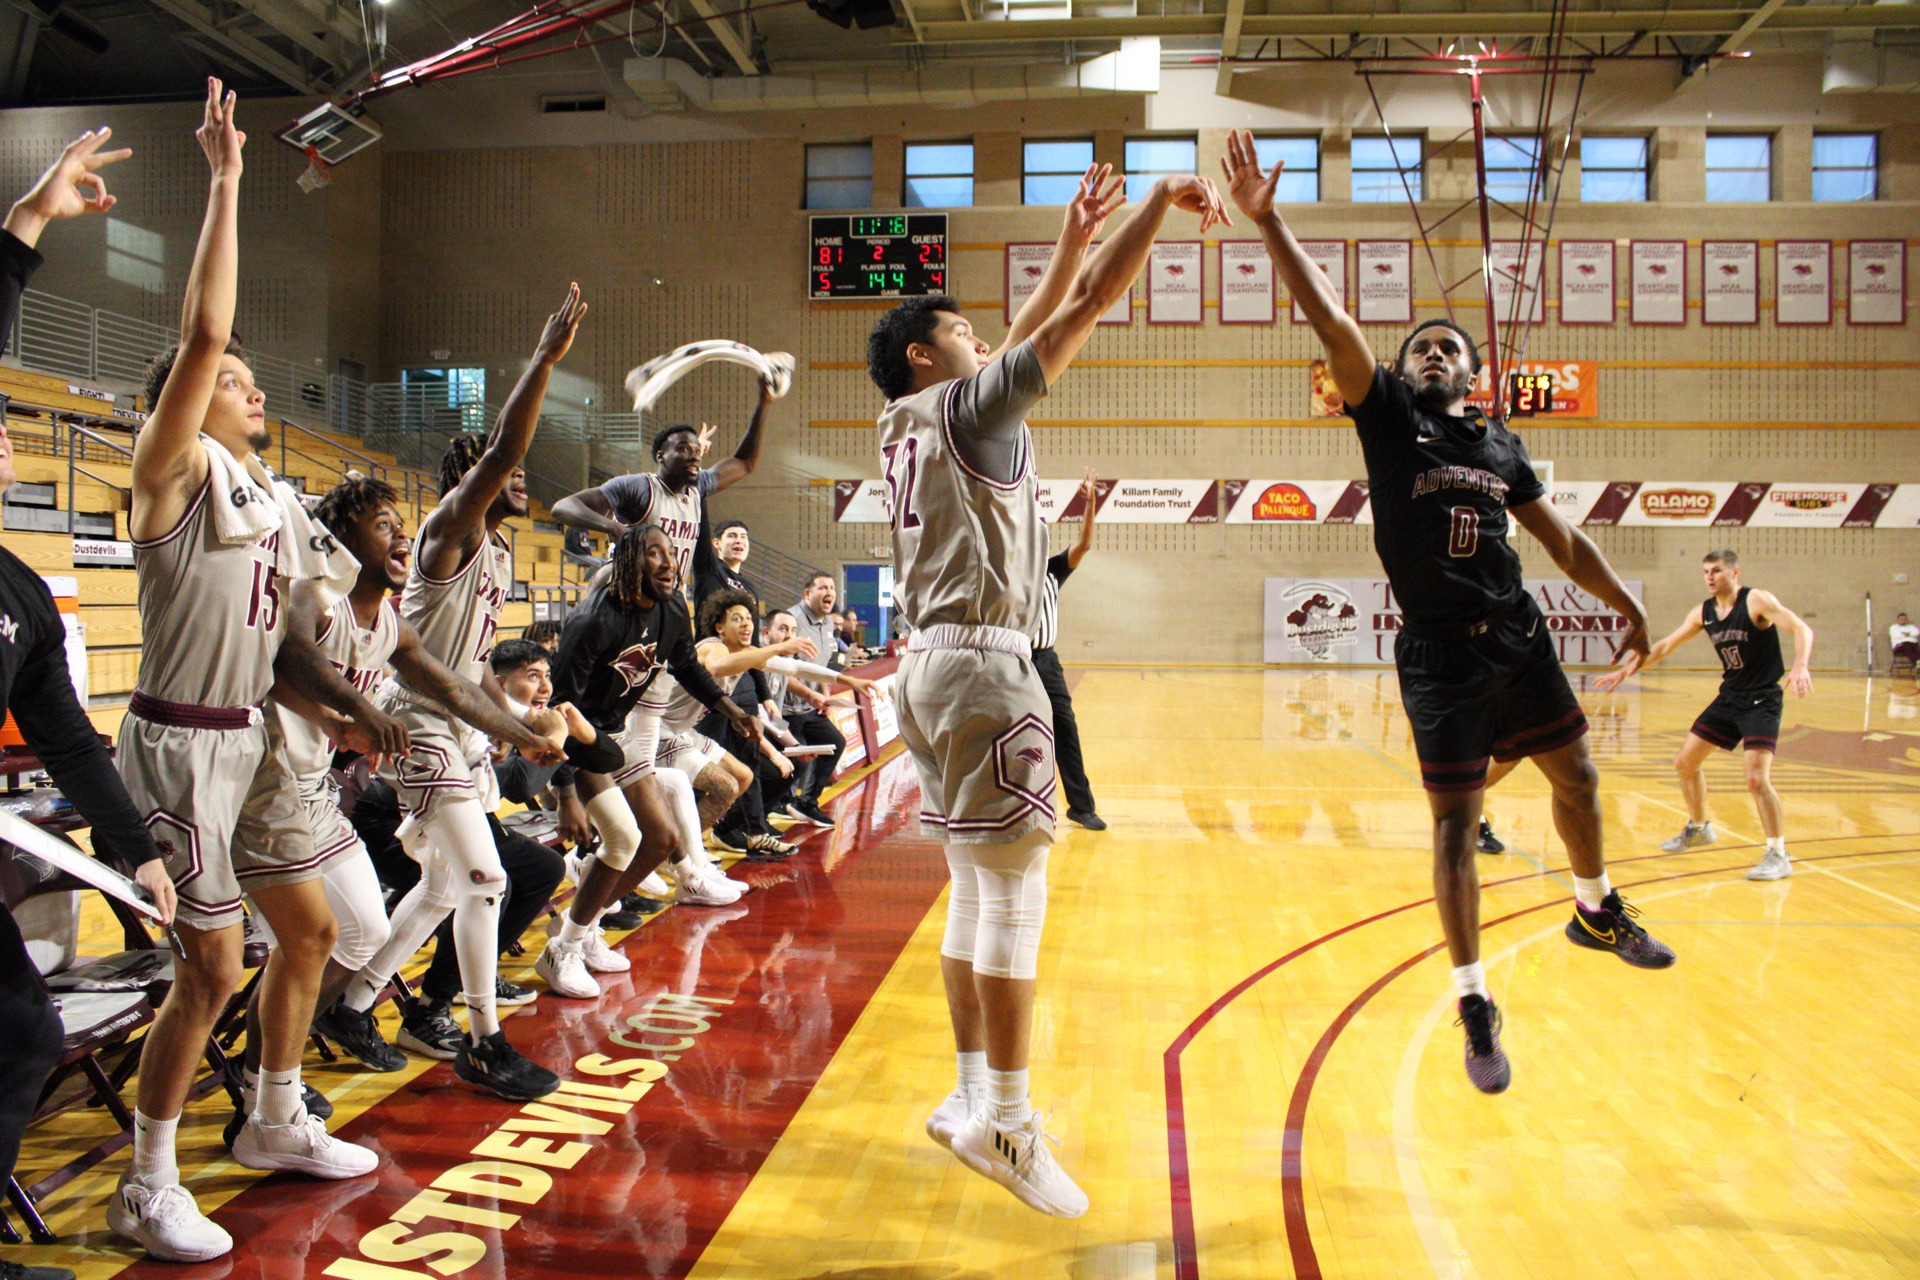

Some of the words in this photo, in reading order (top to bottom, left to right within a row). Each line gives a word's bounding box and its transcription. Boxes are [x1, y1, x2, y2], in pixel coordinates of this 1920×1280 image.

[815, 237, 843, 246] HOME
[911, 235, 944, 244] GUEST
[819, 247, 843, 264] 81
[873, 246, 884, 260] 2
[919, 244, 943, 263] 27
[819, 272, 831, 290] 5
[869, 273, 885, 289] 14
[892, 272, 904, 288] 4
[931, 271, 942, 286] 4
[1518, 388, 1545, 410] 21
[113, 409, 143, 420] TDEVILS
[1122, 488, 1150, 496] Killam
[1153, 488, 1183, 497] Family
[1268, 493, 1300, 504] TACO
[1773, 492, 1847, 502] FIREHOUSE
[1114, 500, 1166, 508] Foundation
[1168, 500, 1191, 508] Trust
[1647, 495, 1710, 508] ALAMO
[1260, 504, 1309, 516] PALENQUE
[1449, 506, 1479, 557] 0
[245, 558, 280, 632] 15
[1286, 618, 1357, 638] Dustdevils
